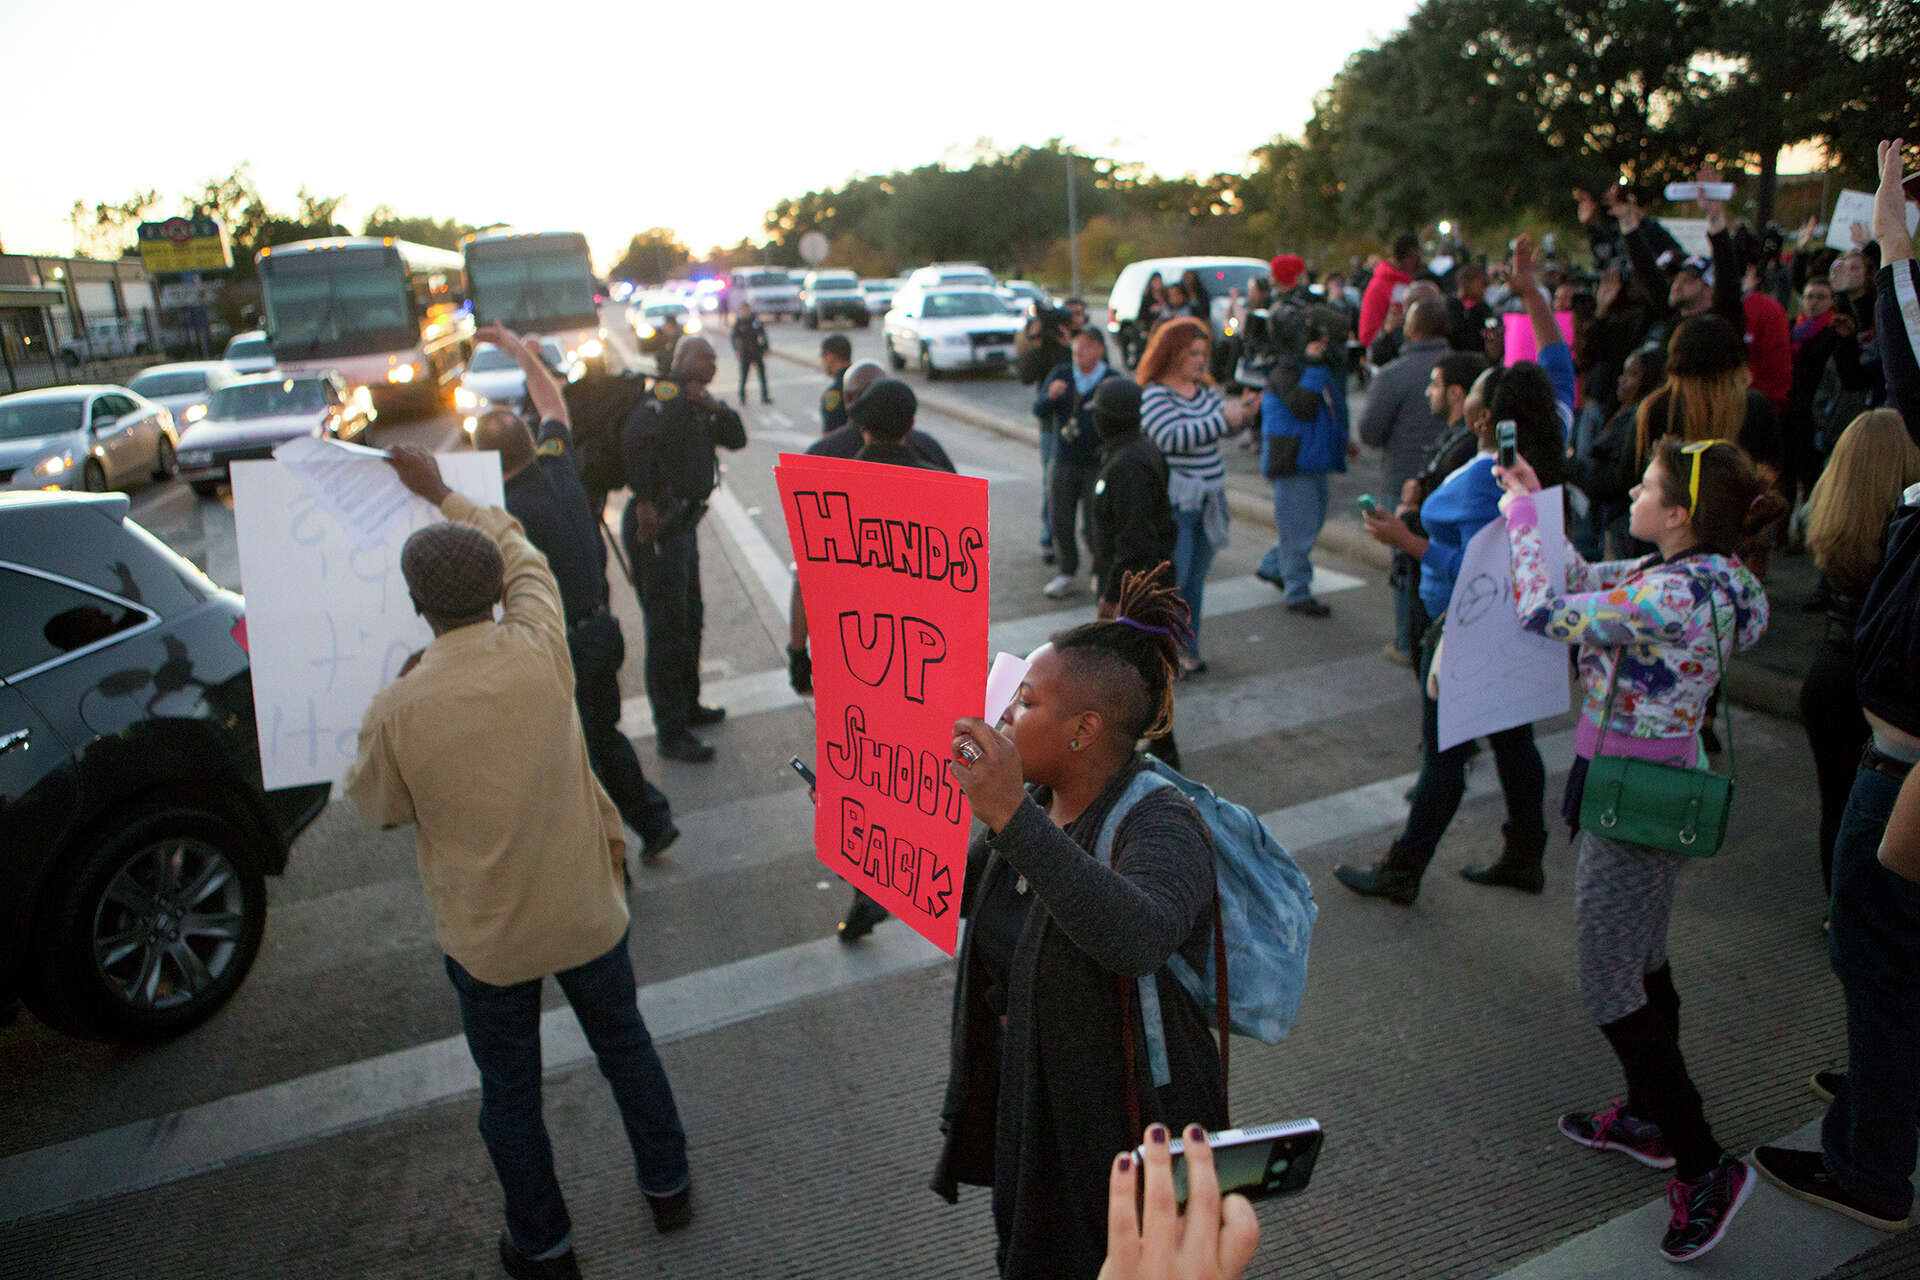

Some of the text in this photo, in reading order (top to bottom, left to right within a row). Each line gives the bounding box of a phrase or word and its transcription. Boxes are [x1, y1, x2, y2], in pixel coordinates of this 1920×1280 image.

[793, 491, 984, 593] HANDS
[838, 610, 946, 704] UP
[826, 704, 967, 825] SHOOT
[840, 796, 953, 919] BACK
